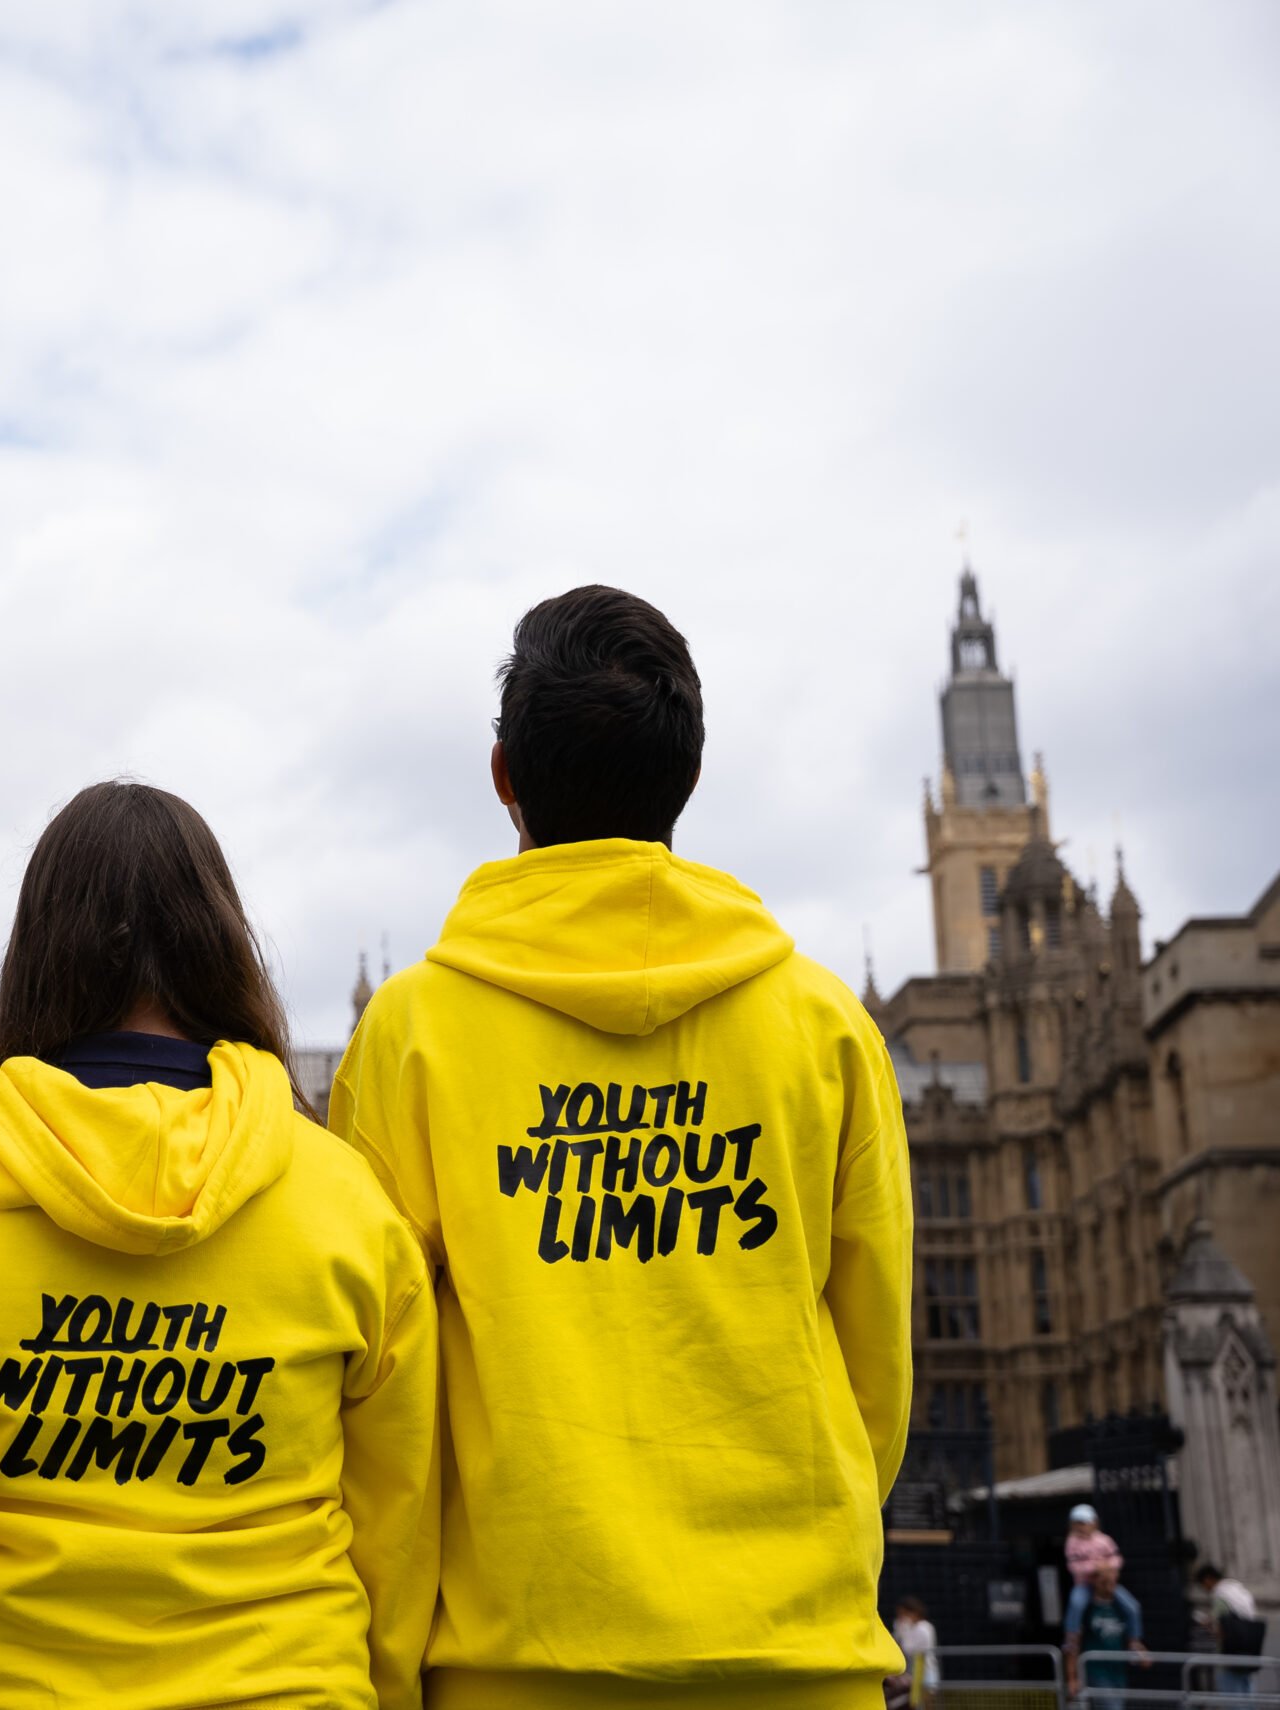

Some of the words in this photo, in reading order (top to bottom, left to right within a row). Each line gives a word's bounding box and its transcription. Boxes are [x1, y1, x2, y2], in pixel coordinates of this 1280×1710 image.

[527, 1080, 708, 1140] YOUTH
[497, 1123, 762, 1198] WITHOUT
[538, 1177, 778, 1264] LIMITS
[19, 1293, 228, 1354] YOUTH
